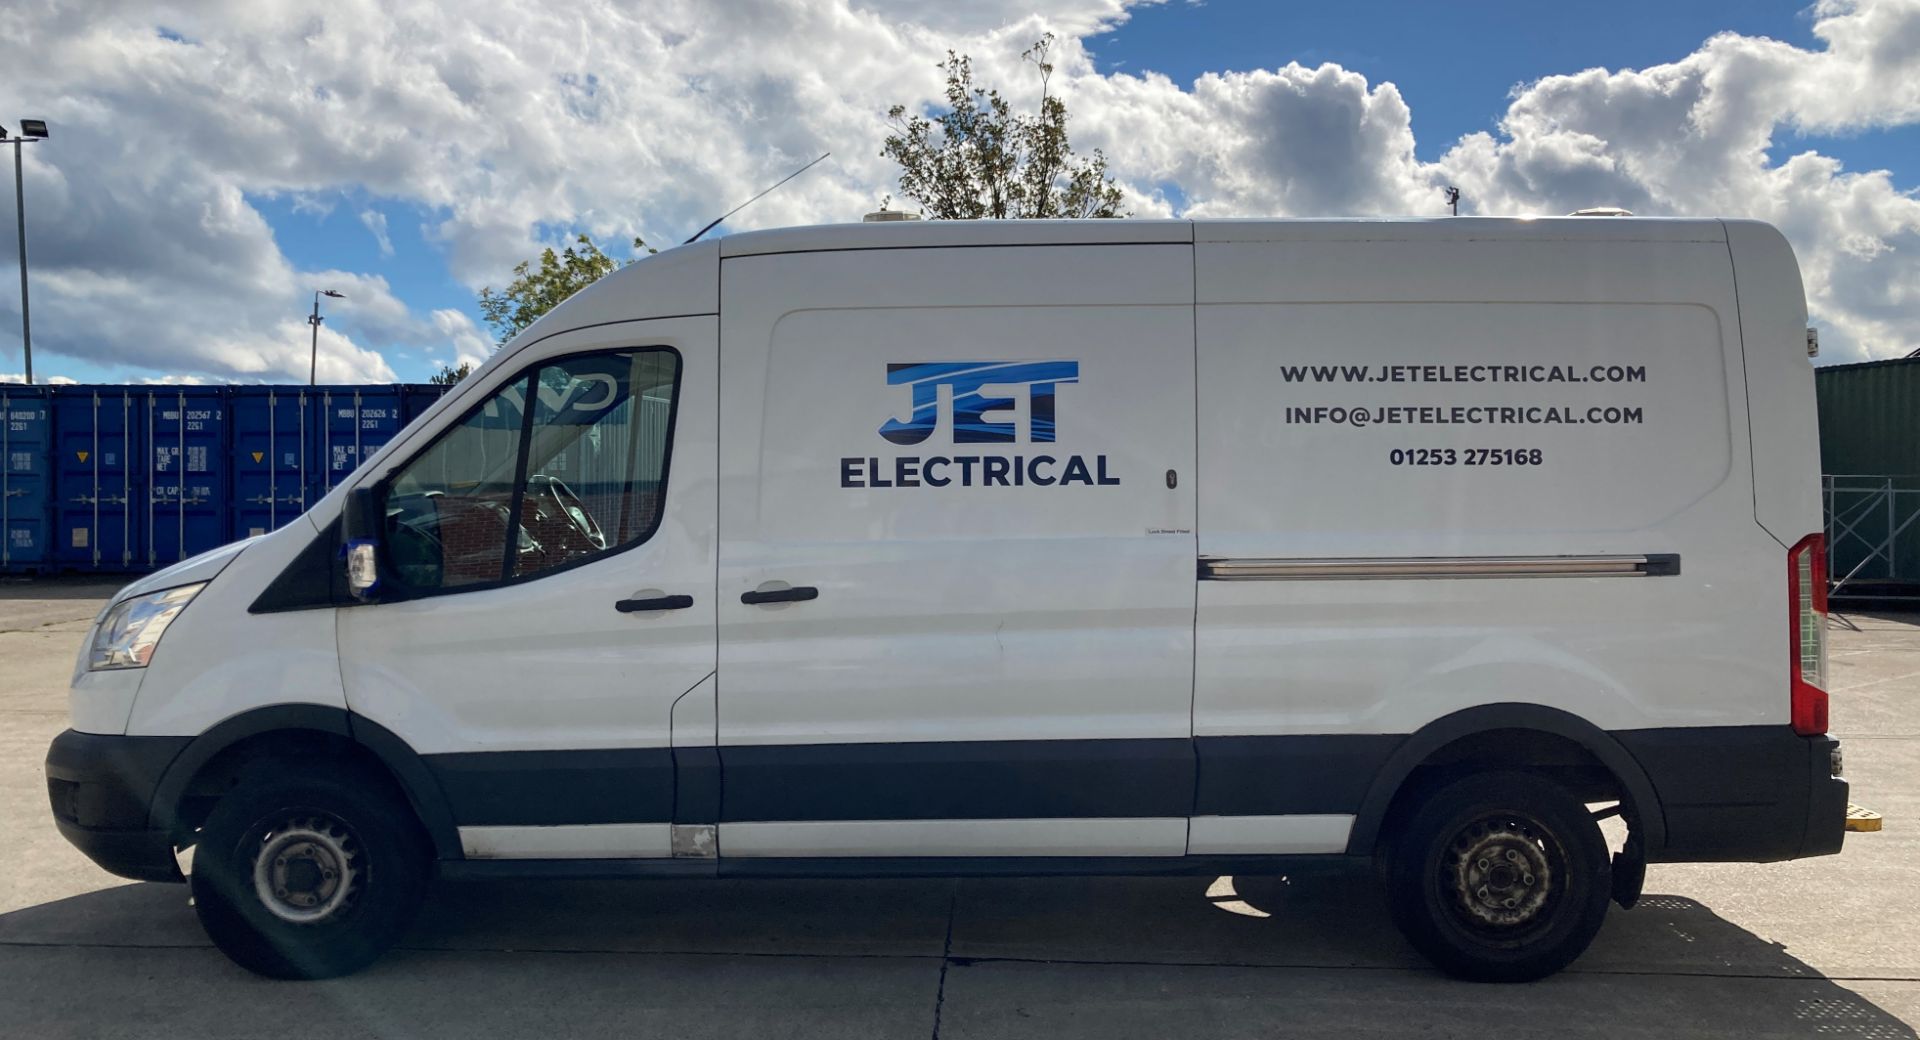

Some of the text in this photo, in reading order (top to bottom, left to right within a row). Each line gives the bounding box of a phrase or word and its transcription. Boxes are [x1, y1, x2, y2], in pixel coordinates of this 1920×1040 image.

[1280, 365, 1646, 383] WWW.JETELECTRICAL.COM
[878, 361, 1079, 445] JET
[1286, 407, 1643, 427] INFO@JETELECTRICAL.COM
[1390, 449, 1543, 466] 01253 275168
[841, 455, 1120, 488] ELECTRICAL
